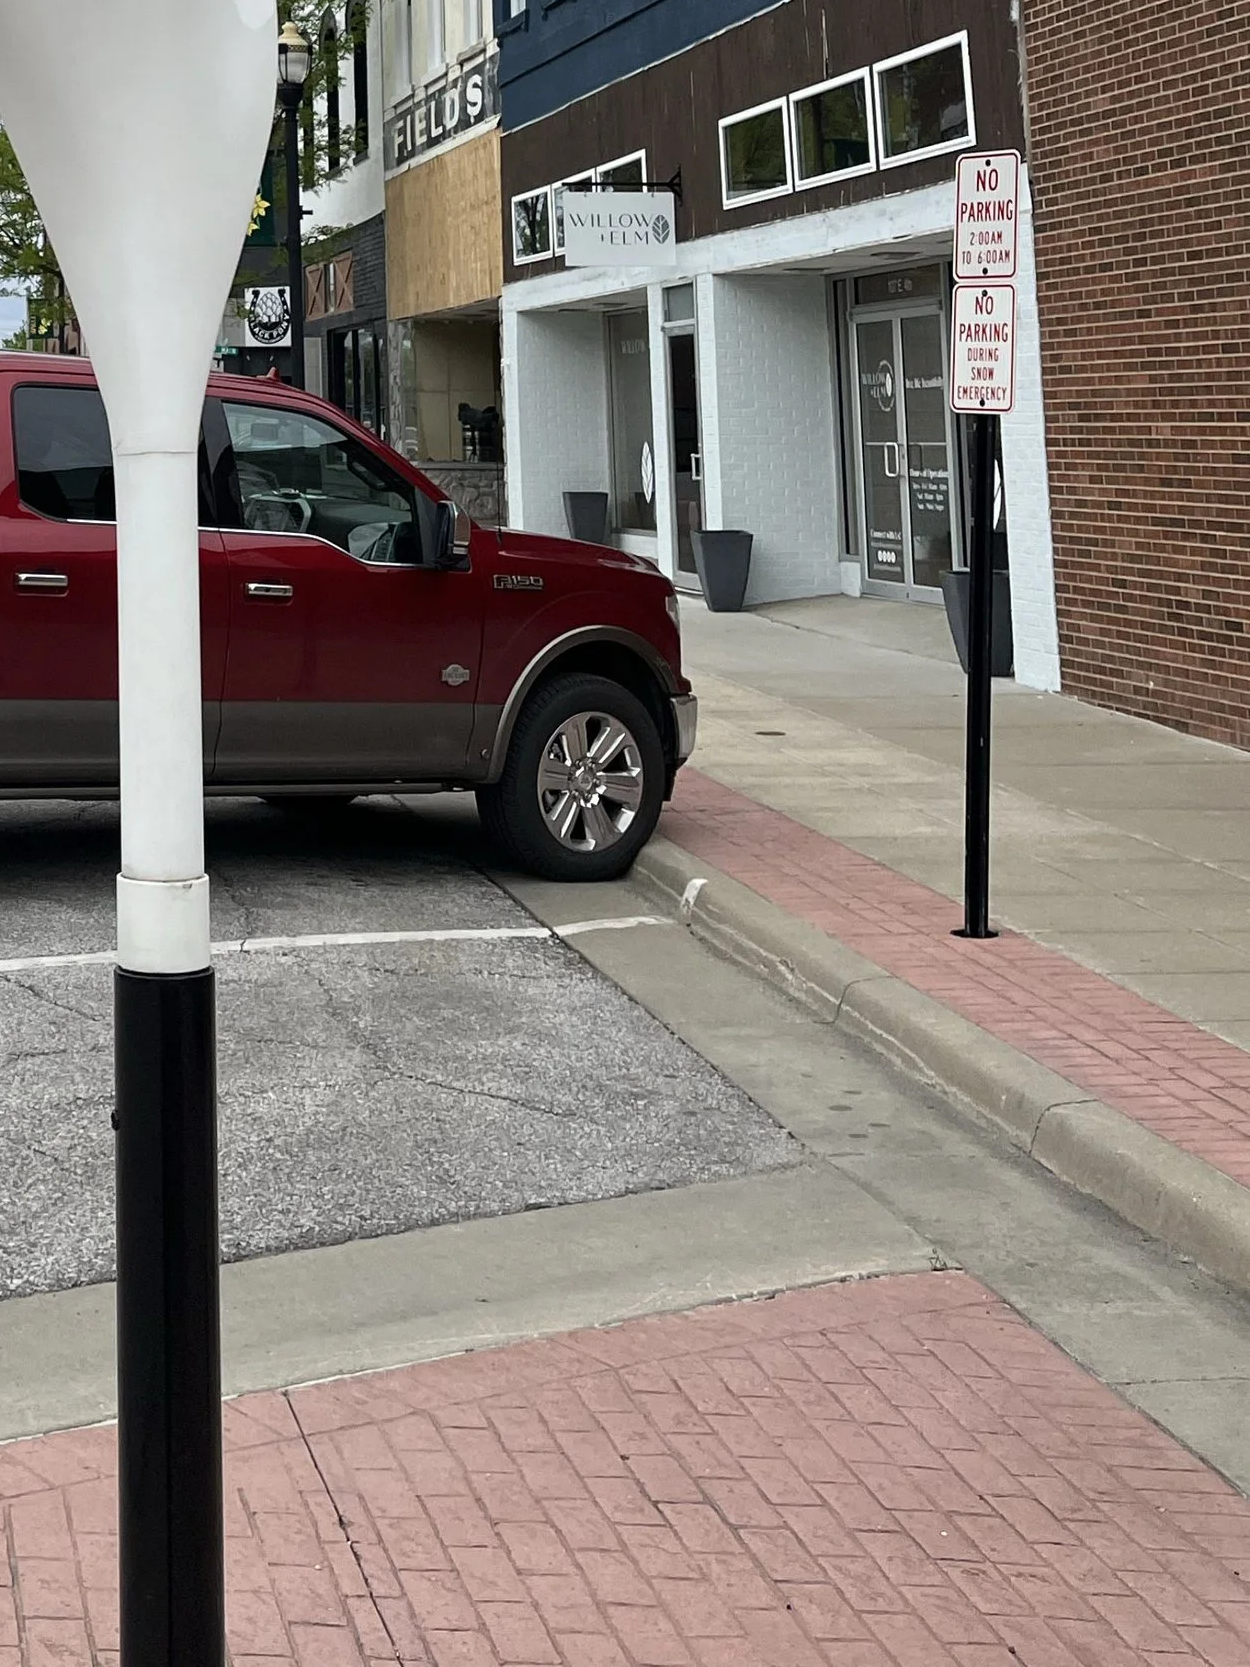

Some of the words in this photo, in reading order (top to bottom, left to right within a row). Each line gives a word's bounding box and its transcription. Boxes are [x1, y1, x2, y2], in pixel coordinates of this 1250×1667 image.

[976, 168, 999, 192] NO
[960, 199, 1013, 223] PARKING
[569, 213, 652, 228] WILLOW
[610, 230, 649, 245] ELM
[970, 231, 1003, 246] 2:00AM
[962, 251, 972, 265] TO
[977, 248, 1011, 264] 6:00AM
[975, 295, 994, 315] NO
[959, 323, 1009, 343] PARKING
[967, 348, 999, 362] DURING
[971, 367, 995, 381] SNOW
[957, 386, 1007, 401] EMERGENCY
